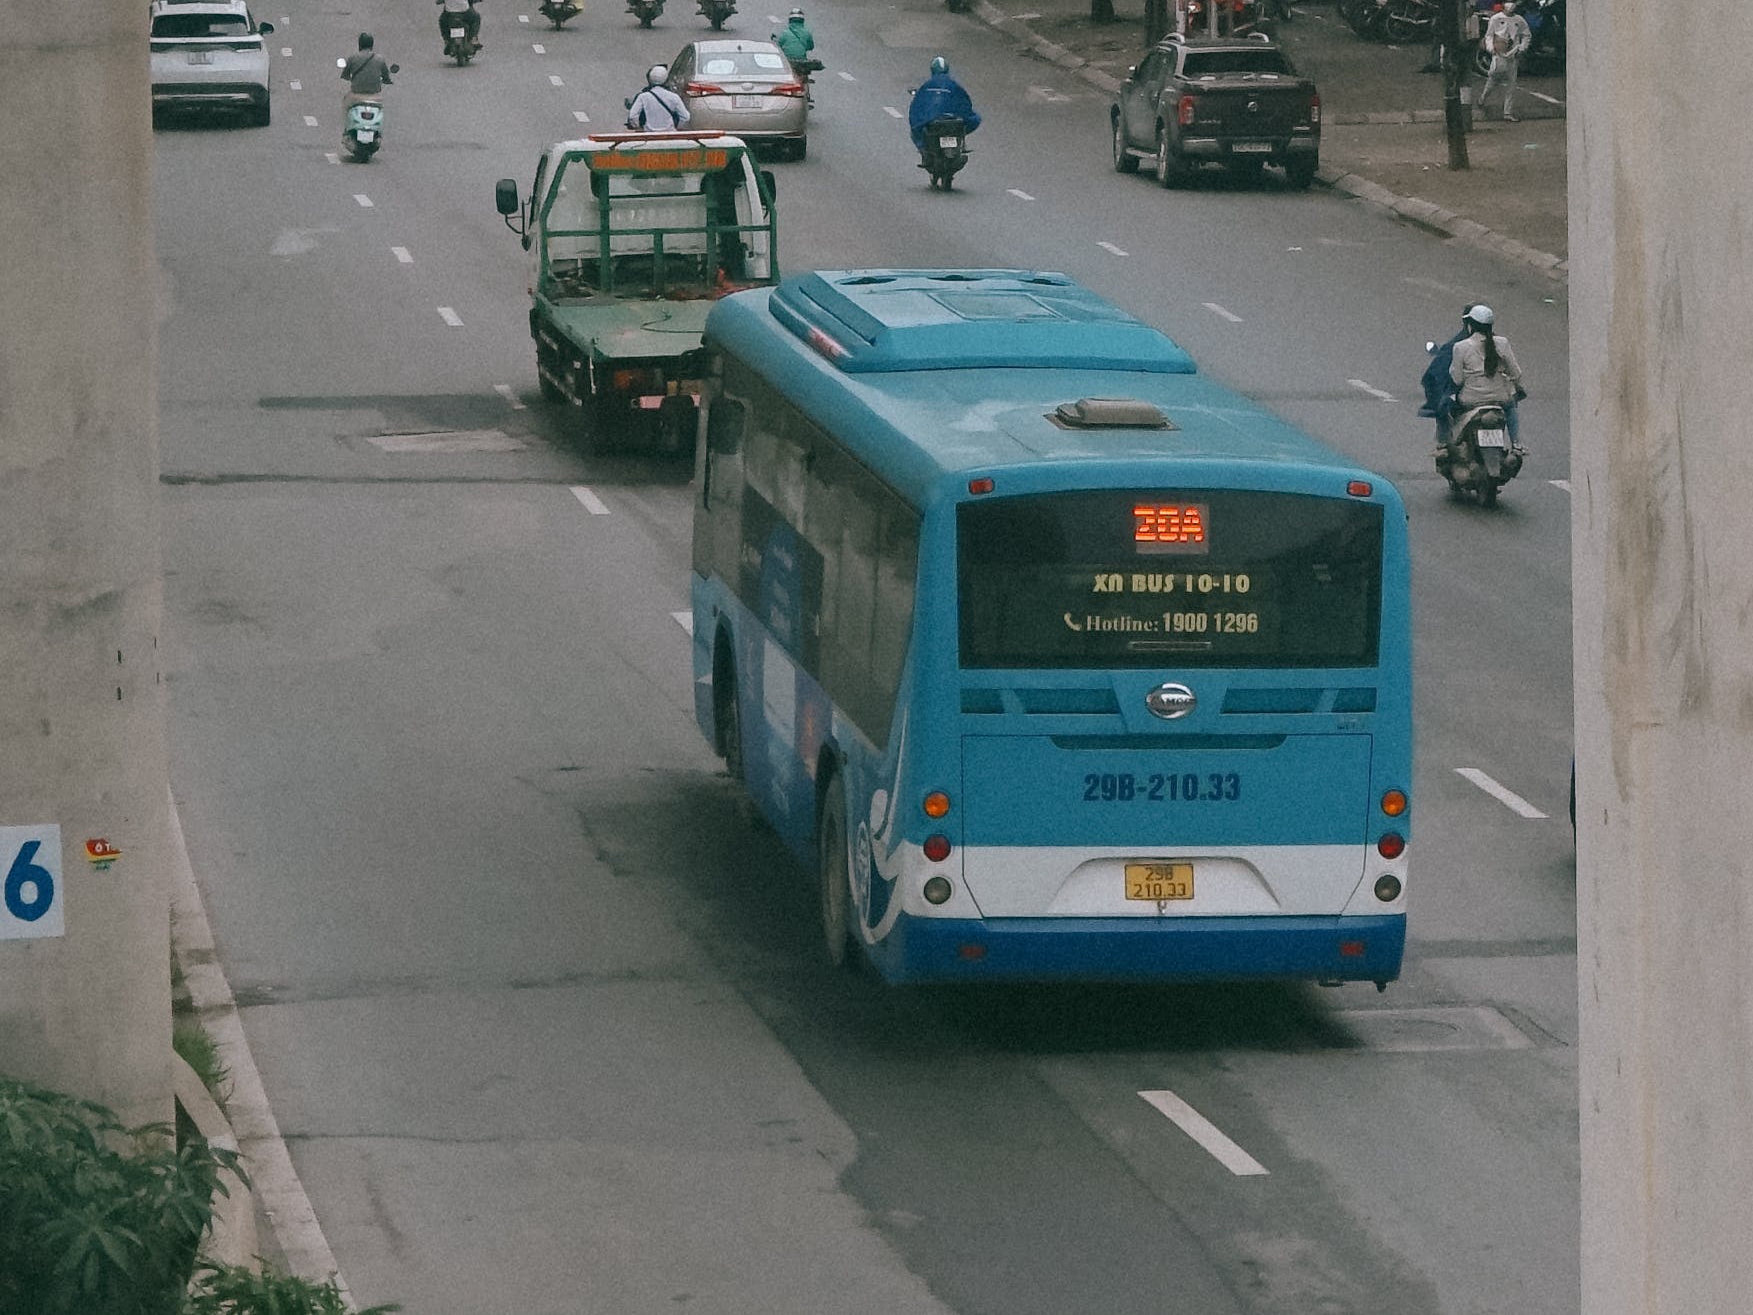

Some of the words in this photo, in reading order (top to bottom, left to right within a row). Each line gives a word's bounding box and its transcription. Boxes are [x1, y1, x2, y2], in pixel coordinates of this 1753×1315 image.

[1132, 573, 1175, 593] BUS
[1185, 573, 1250, 593] 10-10
[1086, 614, 1159, 632] Hotline:
[1163, 612, 1208, 633] 1900
[1214, 612, 1259, 633] 1296
[1083, 773, 1241, 801] 29B-210.33
[4, 840, 55, 922] 6
[1145, 866, 1174, 881] 29B
[1133, 882, 1187, 898] 210.33
